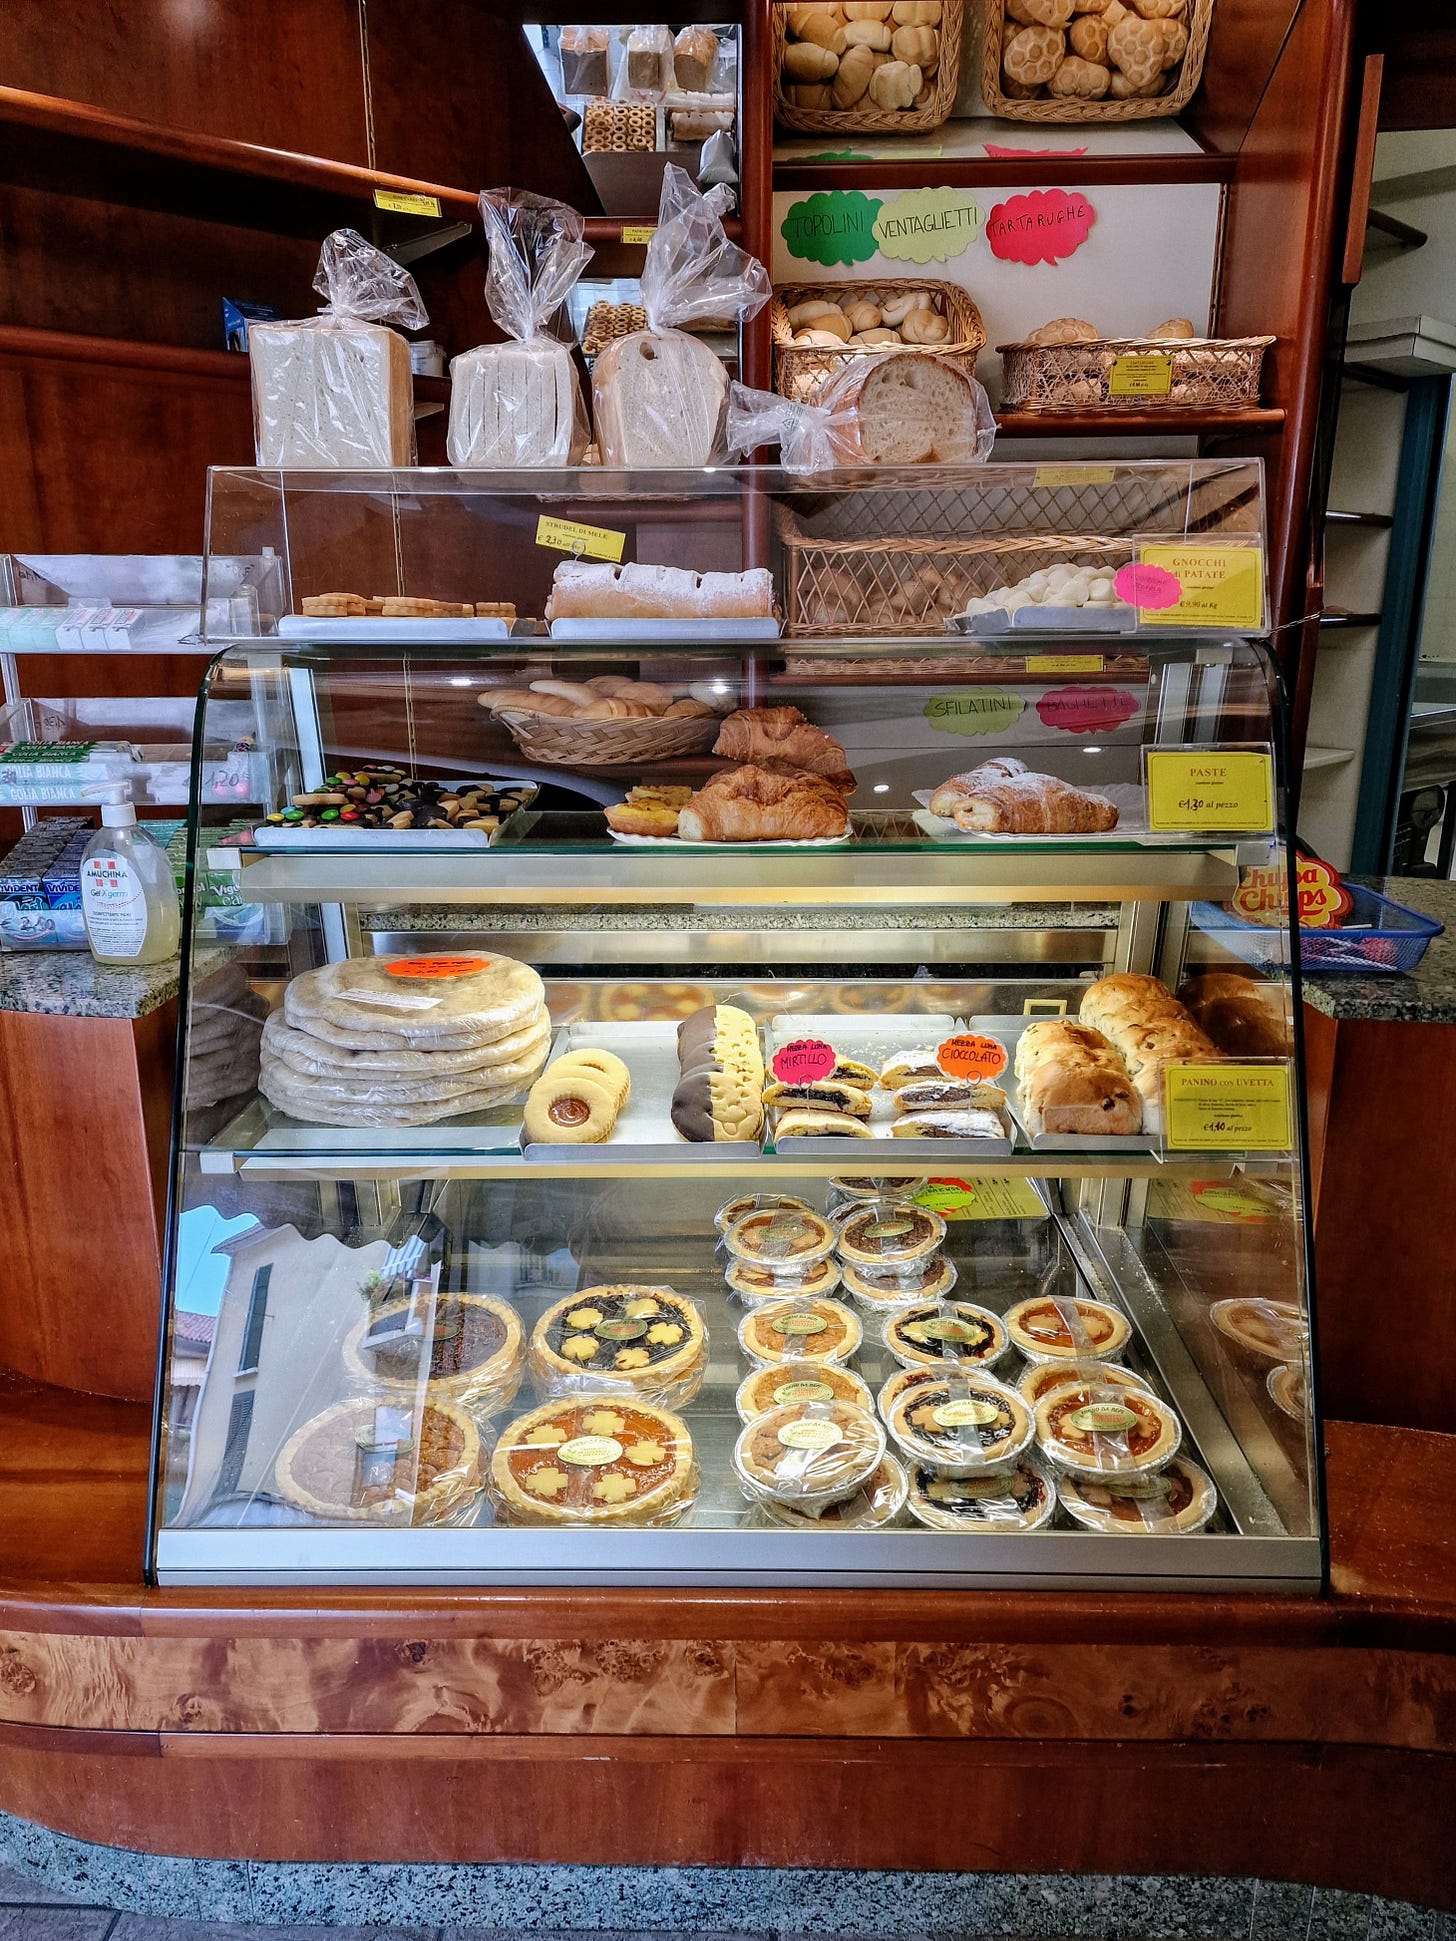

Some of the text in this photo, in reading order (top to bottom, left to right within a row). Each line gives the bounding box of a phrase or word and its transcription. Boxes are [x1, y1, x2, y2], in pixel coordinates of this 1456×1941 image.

[790, 212, 864, 237] TOPOLINI
[879, 206, 978, 239] VENTAGLIETTI
[989, 205, 1085, 238] TARTARUGHE
[545, 521, 577, 533] STRUDEL
[587, 531, 608, 539] MELE
[1172, 558, 1226, 567] GNOCCHI
[1184, 570, 1226, 578] PATATE
[934, 697, 1012, 718] SFILATINI
[36, 765, 71, 779] BIANCA
[1190, 768, 1227, 777] PASTE
[11, 787, 76, 801] GOLIA BIANCA
[1215, 802, 1239, 810] pezzo
[87, 870, 128, 878] AMUCHINA
[47, 884, 81, 893] VIVIDE
[1239, 888, 1327, 919] Chups
[781, 1053, 827, 1070] MIRTILLO
[942, 1047, 1002, 1065] CIOCCOLATO
[1182, 1078, 1217, 1086] PANINO
[1236, 1078, 1274, 1087] UVETTA
